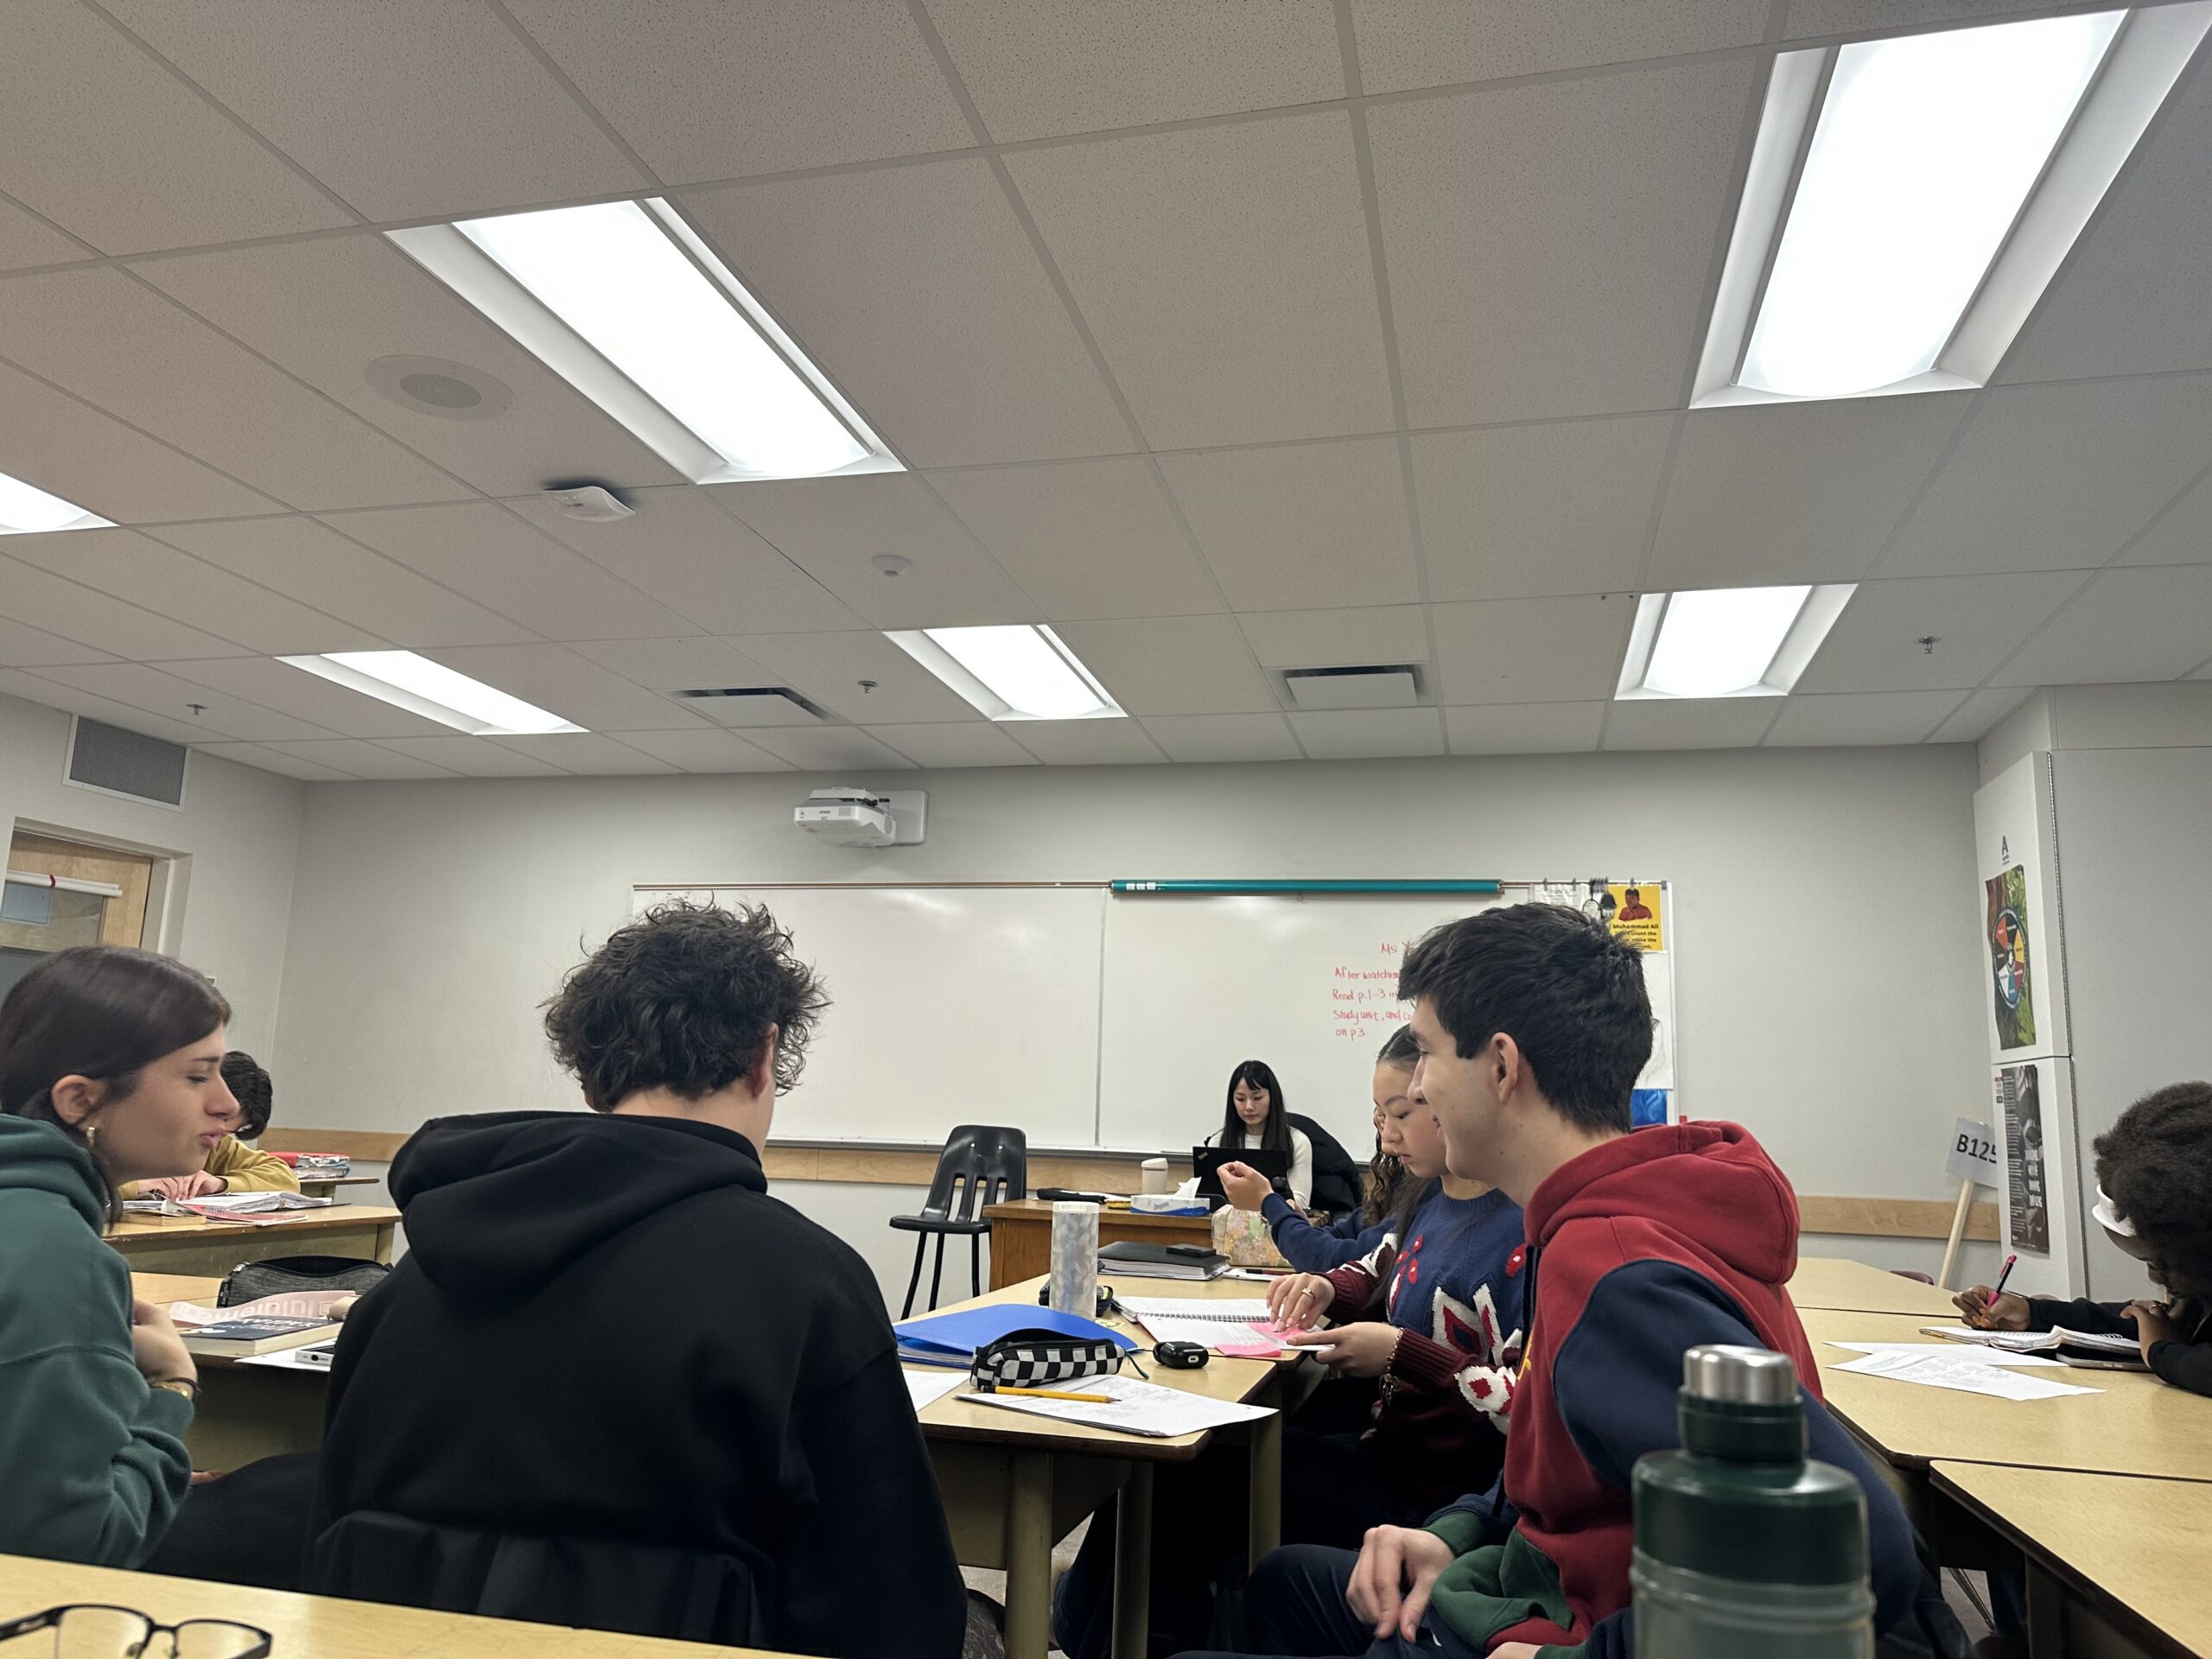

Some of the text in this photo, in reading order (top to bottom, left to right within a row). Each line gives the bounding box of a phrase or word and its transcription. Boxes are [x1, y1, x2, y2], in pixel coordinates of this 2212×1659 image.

[1334, 966, 1359, 979] After
[1332, 988, 1354, 1001] Read
[1333, 1009, 1359, 1025] Study
[1385, 1009, 1402, 1021] and
